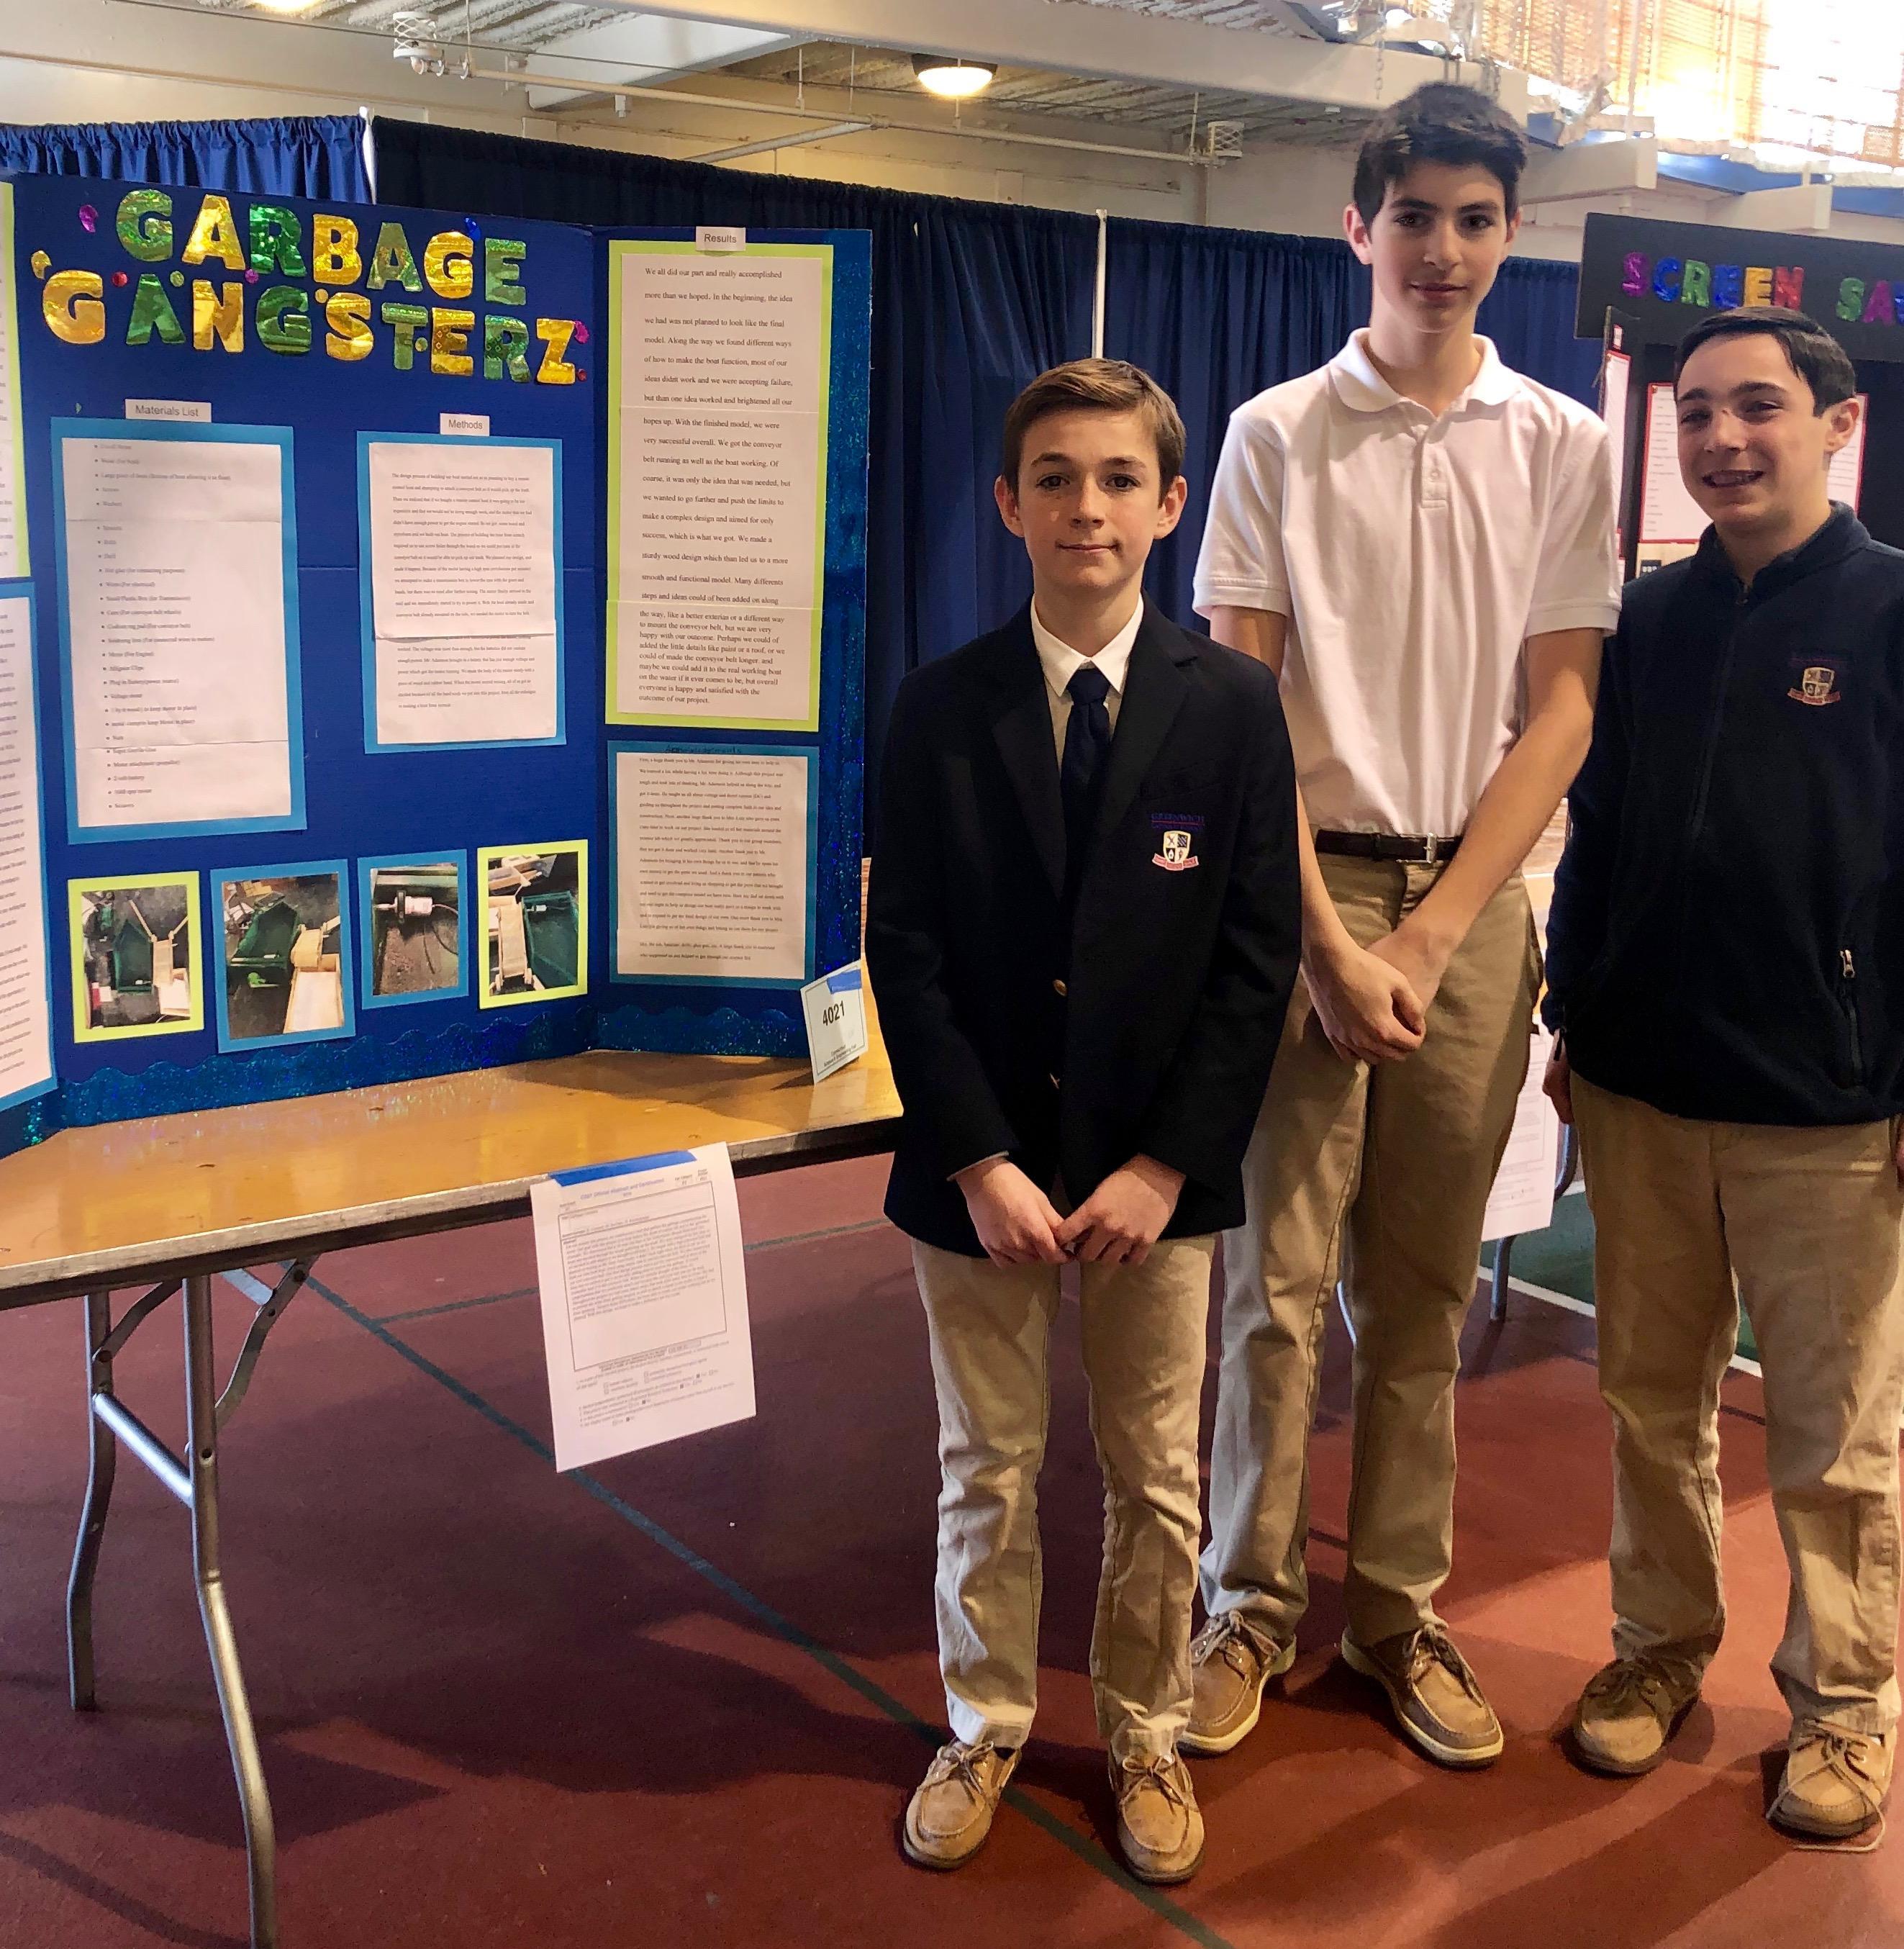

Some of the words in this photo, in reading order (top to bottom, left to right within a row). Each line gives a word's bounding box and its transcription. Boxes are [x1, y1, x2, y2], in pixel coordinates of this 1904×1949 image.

[704, 233, 737, 243] Results
[115, 188, 527, 306] GARBAGE
[691, 268, 704, 278] part
[718, 269, 736, 279] really
[738, 270, 781, 279] accomplished
[1621, 251, 1804, 309] SCREEN
[42, 269, 576, 385] GANGSTERZ
[694, 317, 719, 327] planned
[667, 336, 687, 345] Along
[738, 377, 769, 386] accepting
[135, 404, 180, 417] Materials
[182, 407, 199, 417] List
[448, 419, 483, 430] Methods
[643, 417, 661, 426] hopes
[730, 439, 740, 448] got
[656, 456, 680, 465] running
[686, 476, 699, 485] only
[730, 497, 745, 505] push
[665, 513, 692, 523] complex
[694, 514, 714, 523] design
[760, 517, 773, 525] only
[641, 551, 661, 561] sturdy
[681, 553, 702, 562] design
[734, 576, 751, 586] Many
[822, 1000, 846, 1026] 4021
